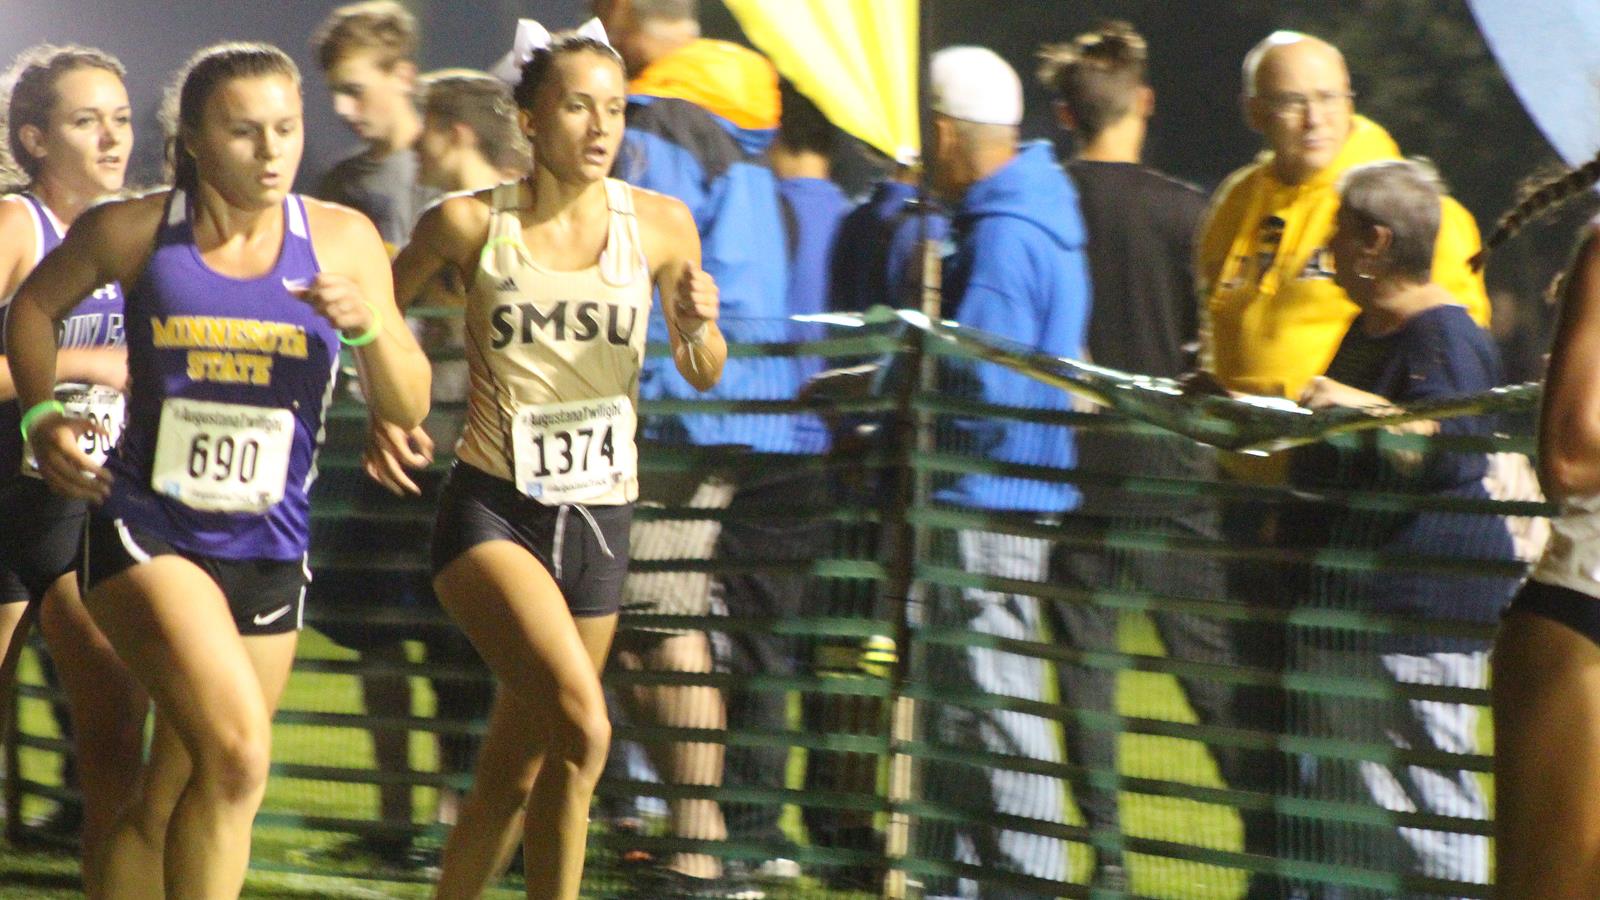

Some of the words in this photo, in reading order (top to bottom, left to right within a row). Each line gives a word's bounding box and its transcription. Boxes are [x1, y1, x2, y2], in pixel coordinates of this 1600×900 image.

[151, 315, 308, 360] MINNESOTA
[491, 302, 637, 349] SMSU
[186, 351, 273, 386] STATE
[73, 411, 110, 456] 90
[533, 425, 615, 477] 1374
[187, 432, 259, 483] 690
